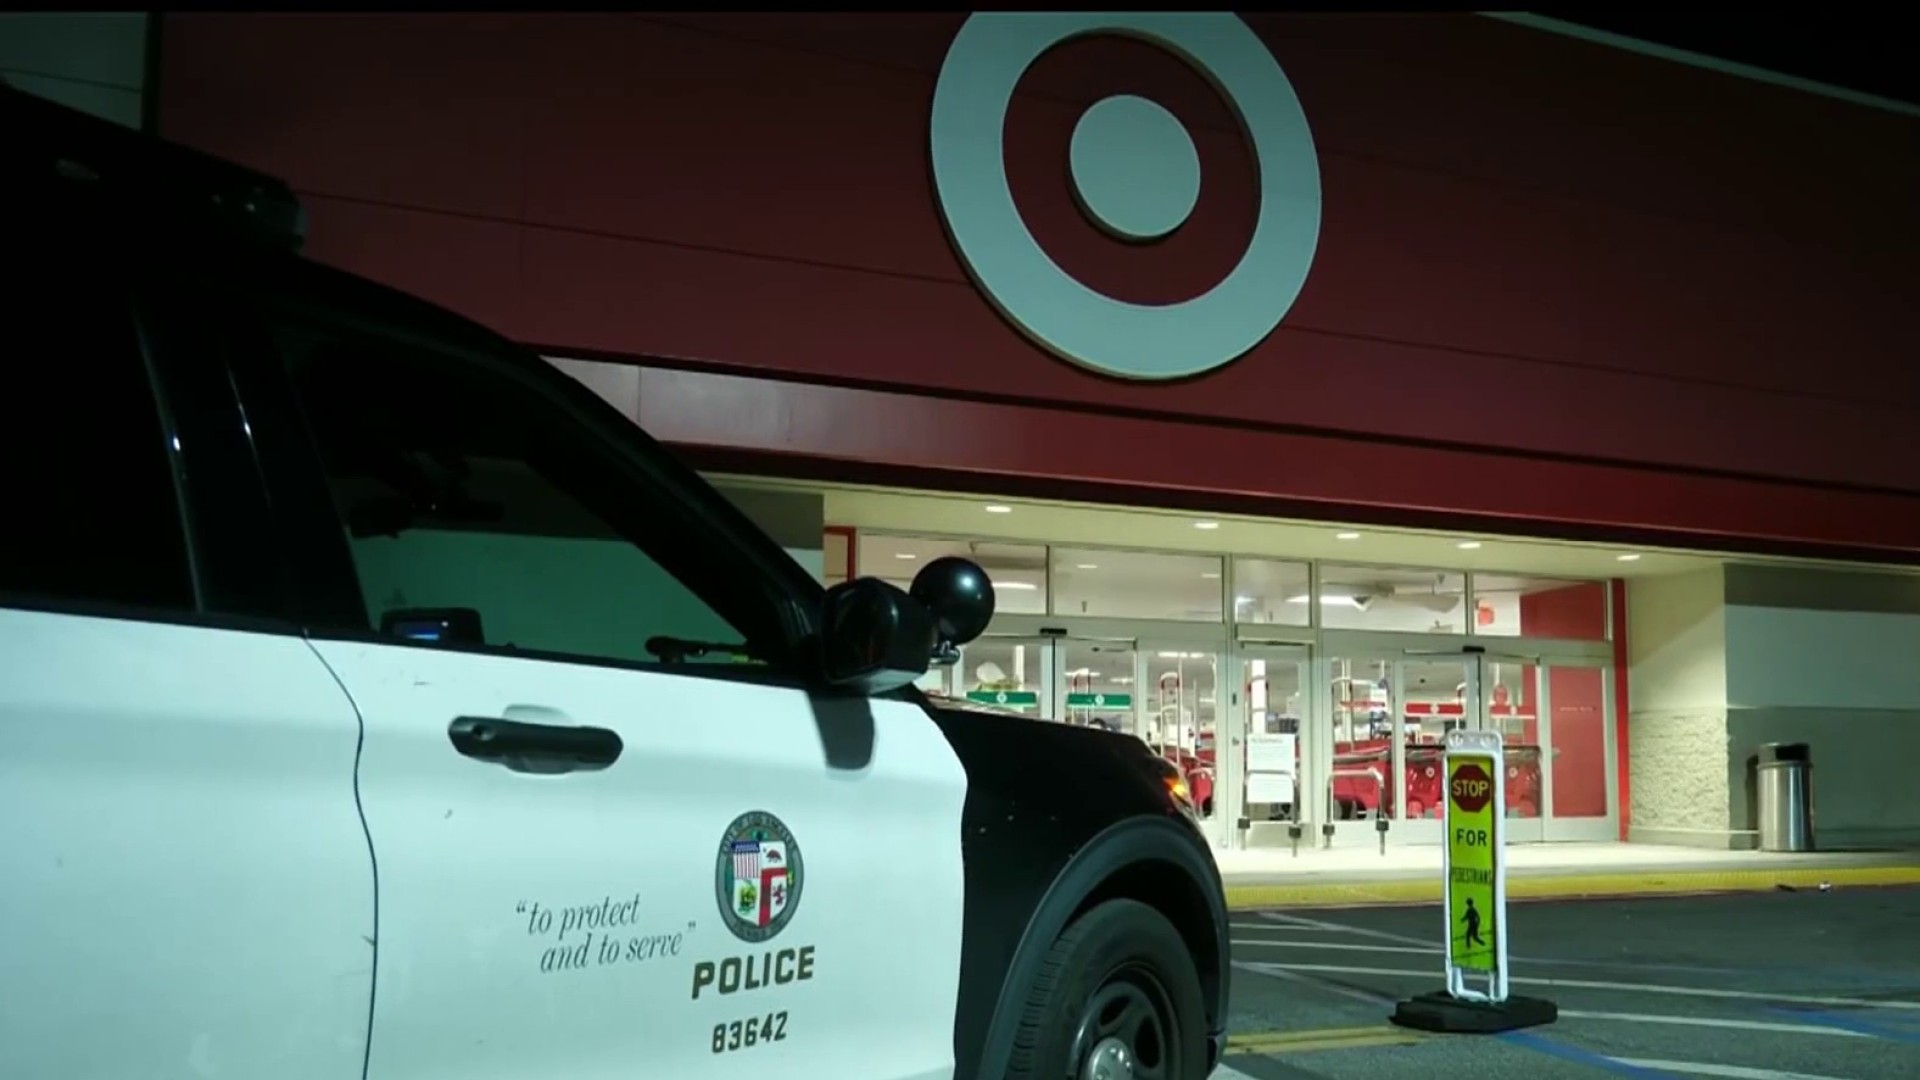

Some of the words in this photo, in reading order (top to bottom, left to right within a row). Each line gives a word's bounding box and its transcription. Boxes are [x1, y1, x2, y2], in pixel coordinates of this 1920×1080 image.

[1451, 780, 1489, 798] STOP
[1456, 828, 1487, 846] FOR
[558, 893, 640, 941] protect
[540, 932, 592, 973] and
[598, 934, 620, 966] to
[692, 946, 815, 1000] POLICE
[711, 1011, 788, 1054] 83642
